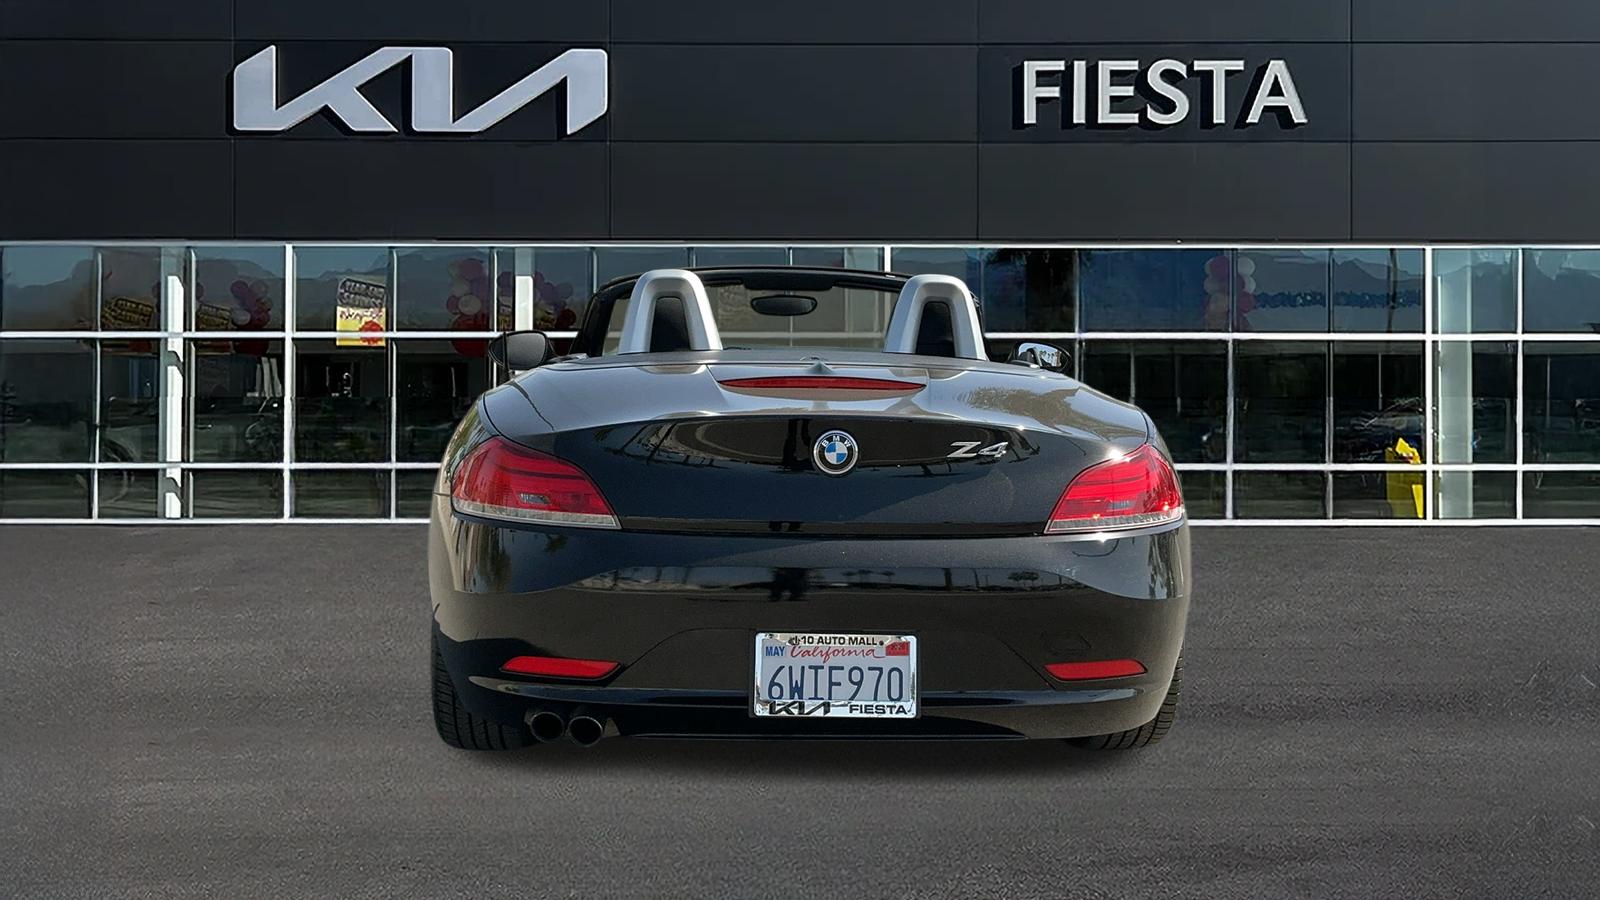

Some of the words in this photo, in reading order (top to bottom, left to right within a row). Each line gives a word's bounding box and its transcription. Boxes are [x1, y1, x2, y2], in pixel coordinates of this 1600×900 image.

[1023, 59, 1308, 125] FIESTA
[821, 435, 851, 447] BMW
[947, 441, 1009, 458] Z4
[816, 636, 846, 646] AUTO
[848, 637, 877, 646] MALL
[765, 646, 785, 657] MAY
[790, 645, 886, 664] California
[767, 665, 904, 702] 6WIF970
[849, 704, 908, 715] FIESTA
